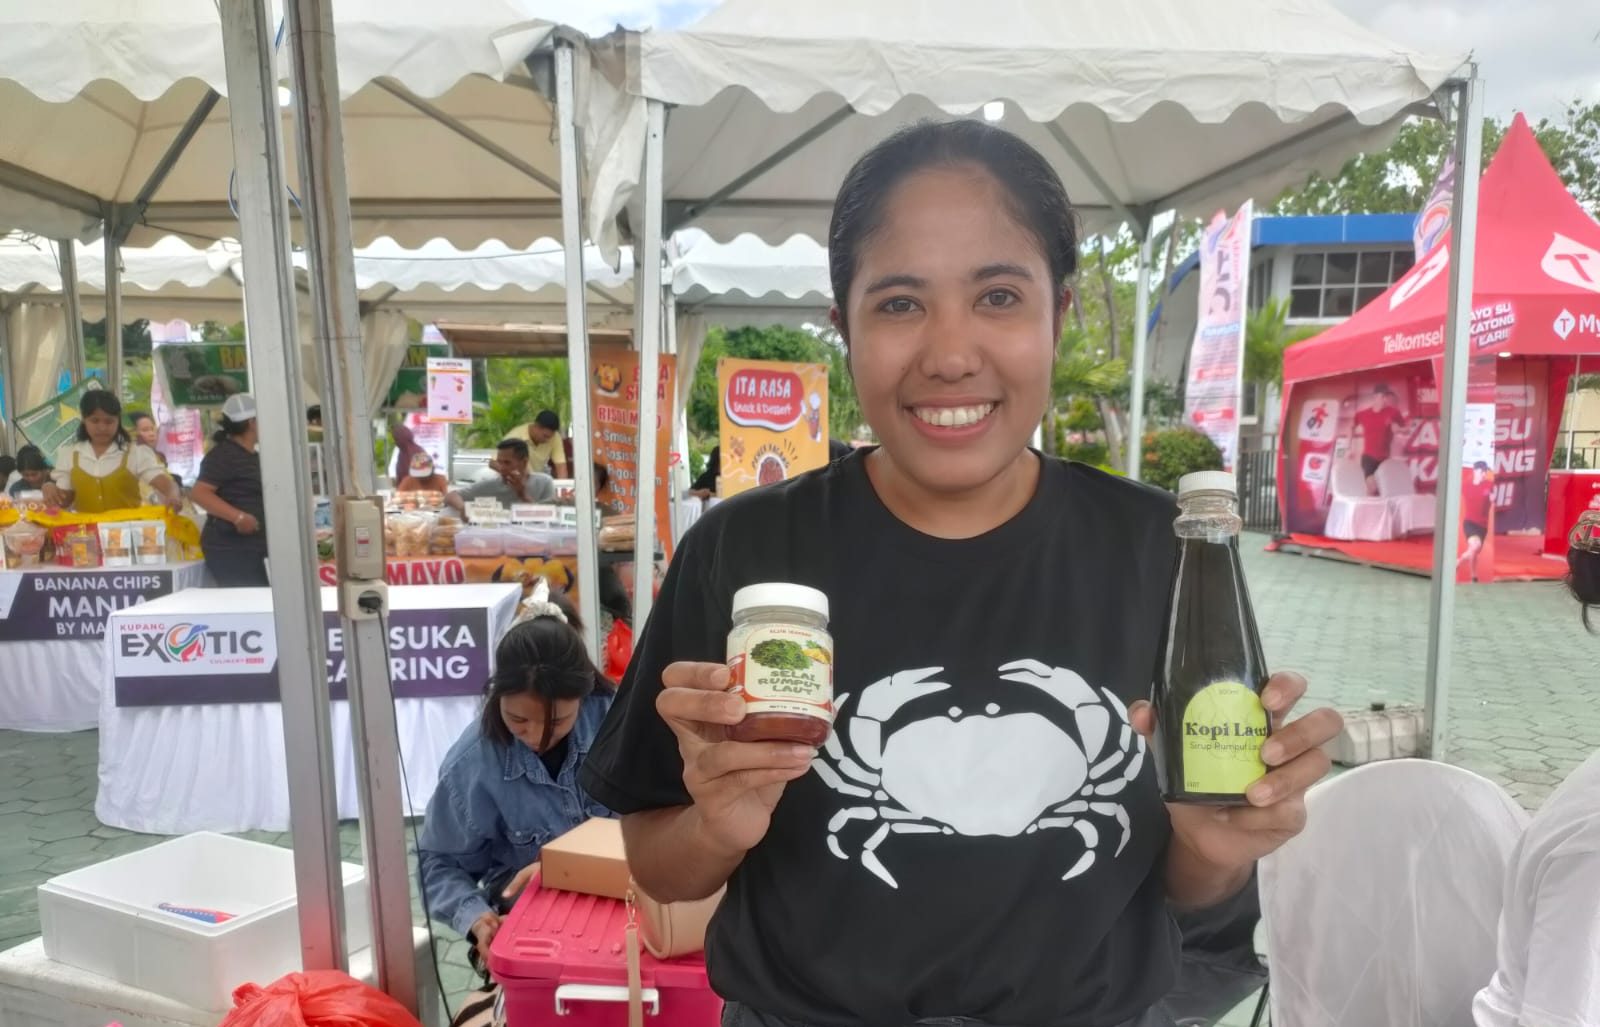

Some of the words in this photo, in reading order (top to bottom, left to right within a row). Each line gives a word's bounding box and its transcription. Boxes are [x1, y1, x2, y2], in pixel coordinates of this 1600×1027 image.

[1494, 302, 1511, 315] SU
[1382, 325, 1444, 354] Telkomsel
[735, 376, 756, 397] ITA
[760, 378, 791, 399] RASA
[386, 559, 465, 586] MAYO
[34, 577, 107, 591] BANANA
[112, 575, 161, 590] CHIPS
[56, 622, 76, 635] BY
[119, 623, 165, 632] KUPANG
[121, 623, 263, 662] EXOTIC
[770, 670, 816, 681] SELAI
[758, 677, 821, 691] RUMPUT
[772, 685, 813, 695] LAUT
[1185, 722, 1230, 740] Kopi
[1190, 741, 1212, 752] Sirup
[1214, 741, 1247, 752] Rumput
